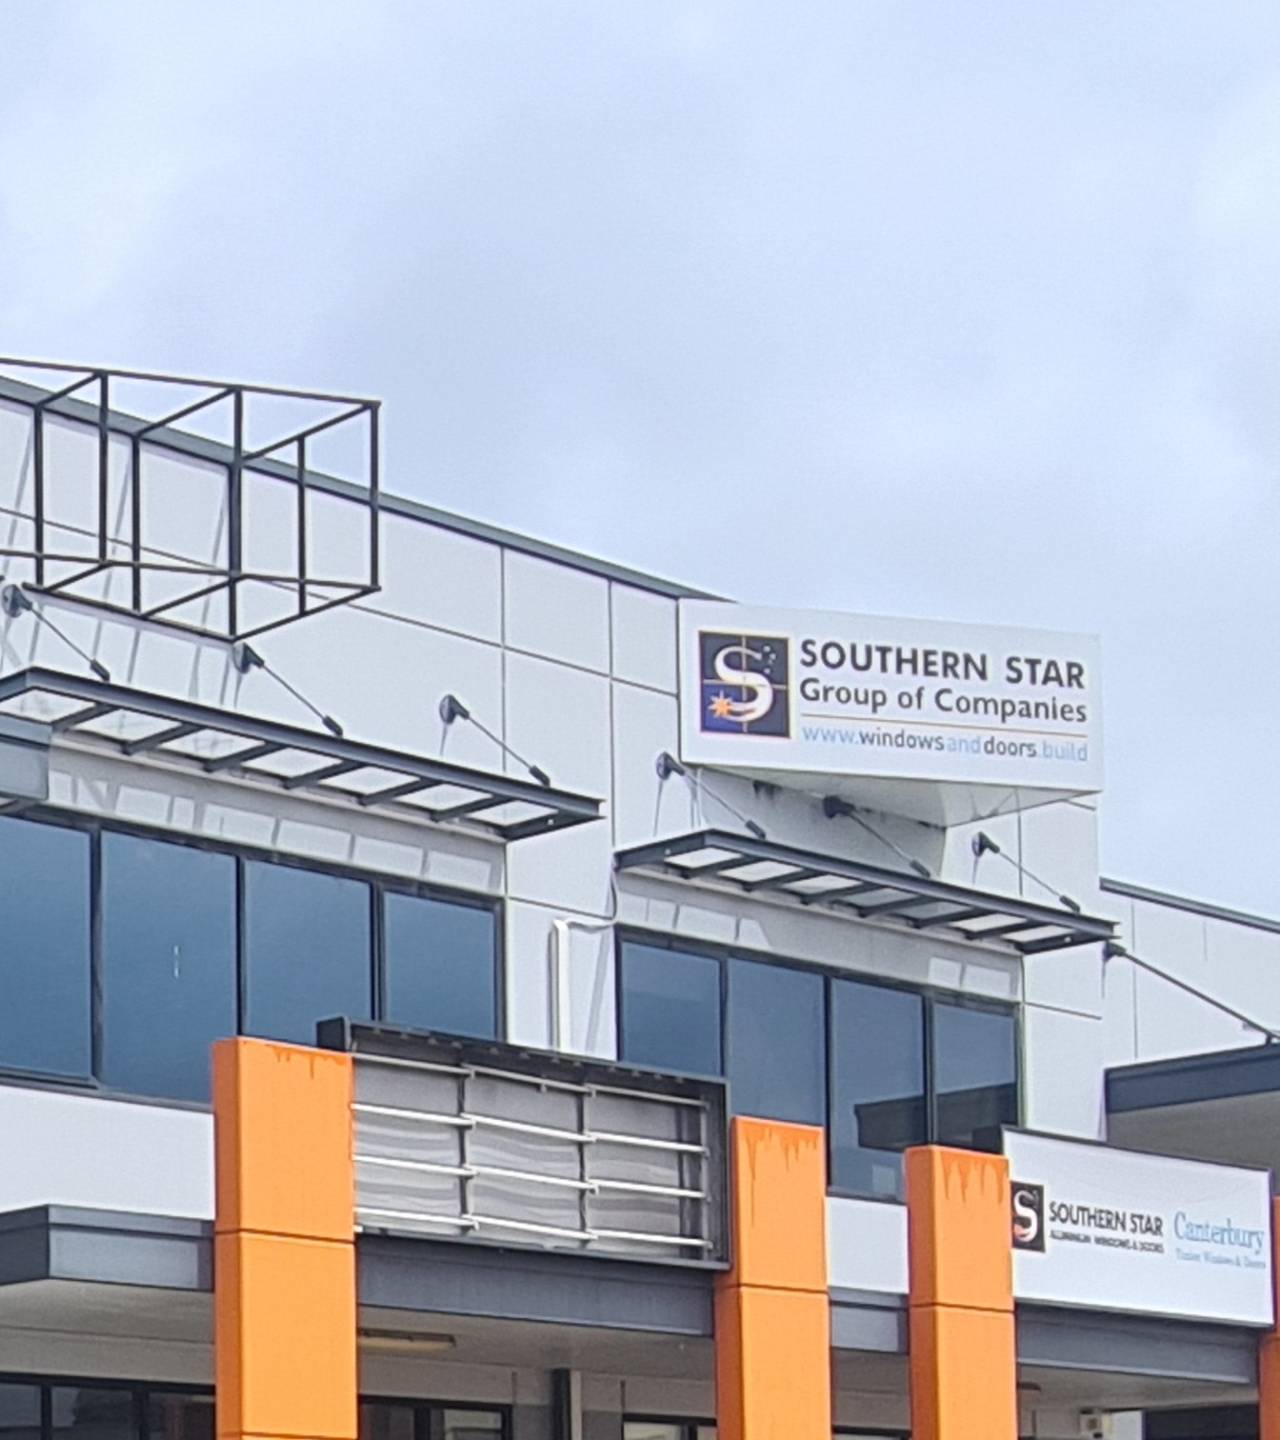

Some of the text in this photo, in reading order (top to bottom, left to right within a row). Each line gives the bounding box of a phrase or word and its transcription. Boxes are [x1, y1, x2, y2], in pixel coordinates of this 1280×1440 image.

[800, 639, 1085, 689] SOUTHERN STAR
[800, 677, 1088, 724] Group of Companies
[802, 726, 1089, 762] www.windowsanddoors.build
[1049, 1201, 1163, 1237] SOUTHERN STAR
[1174, 1211, 1265, 1255] Canterbury
